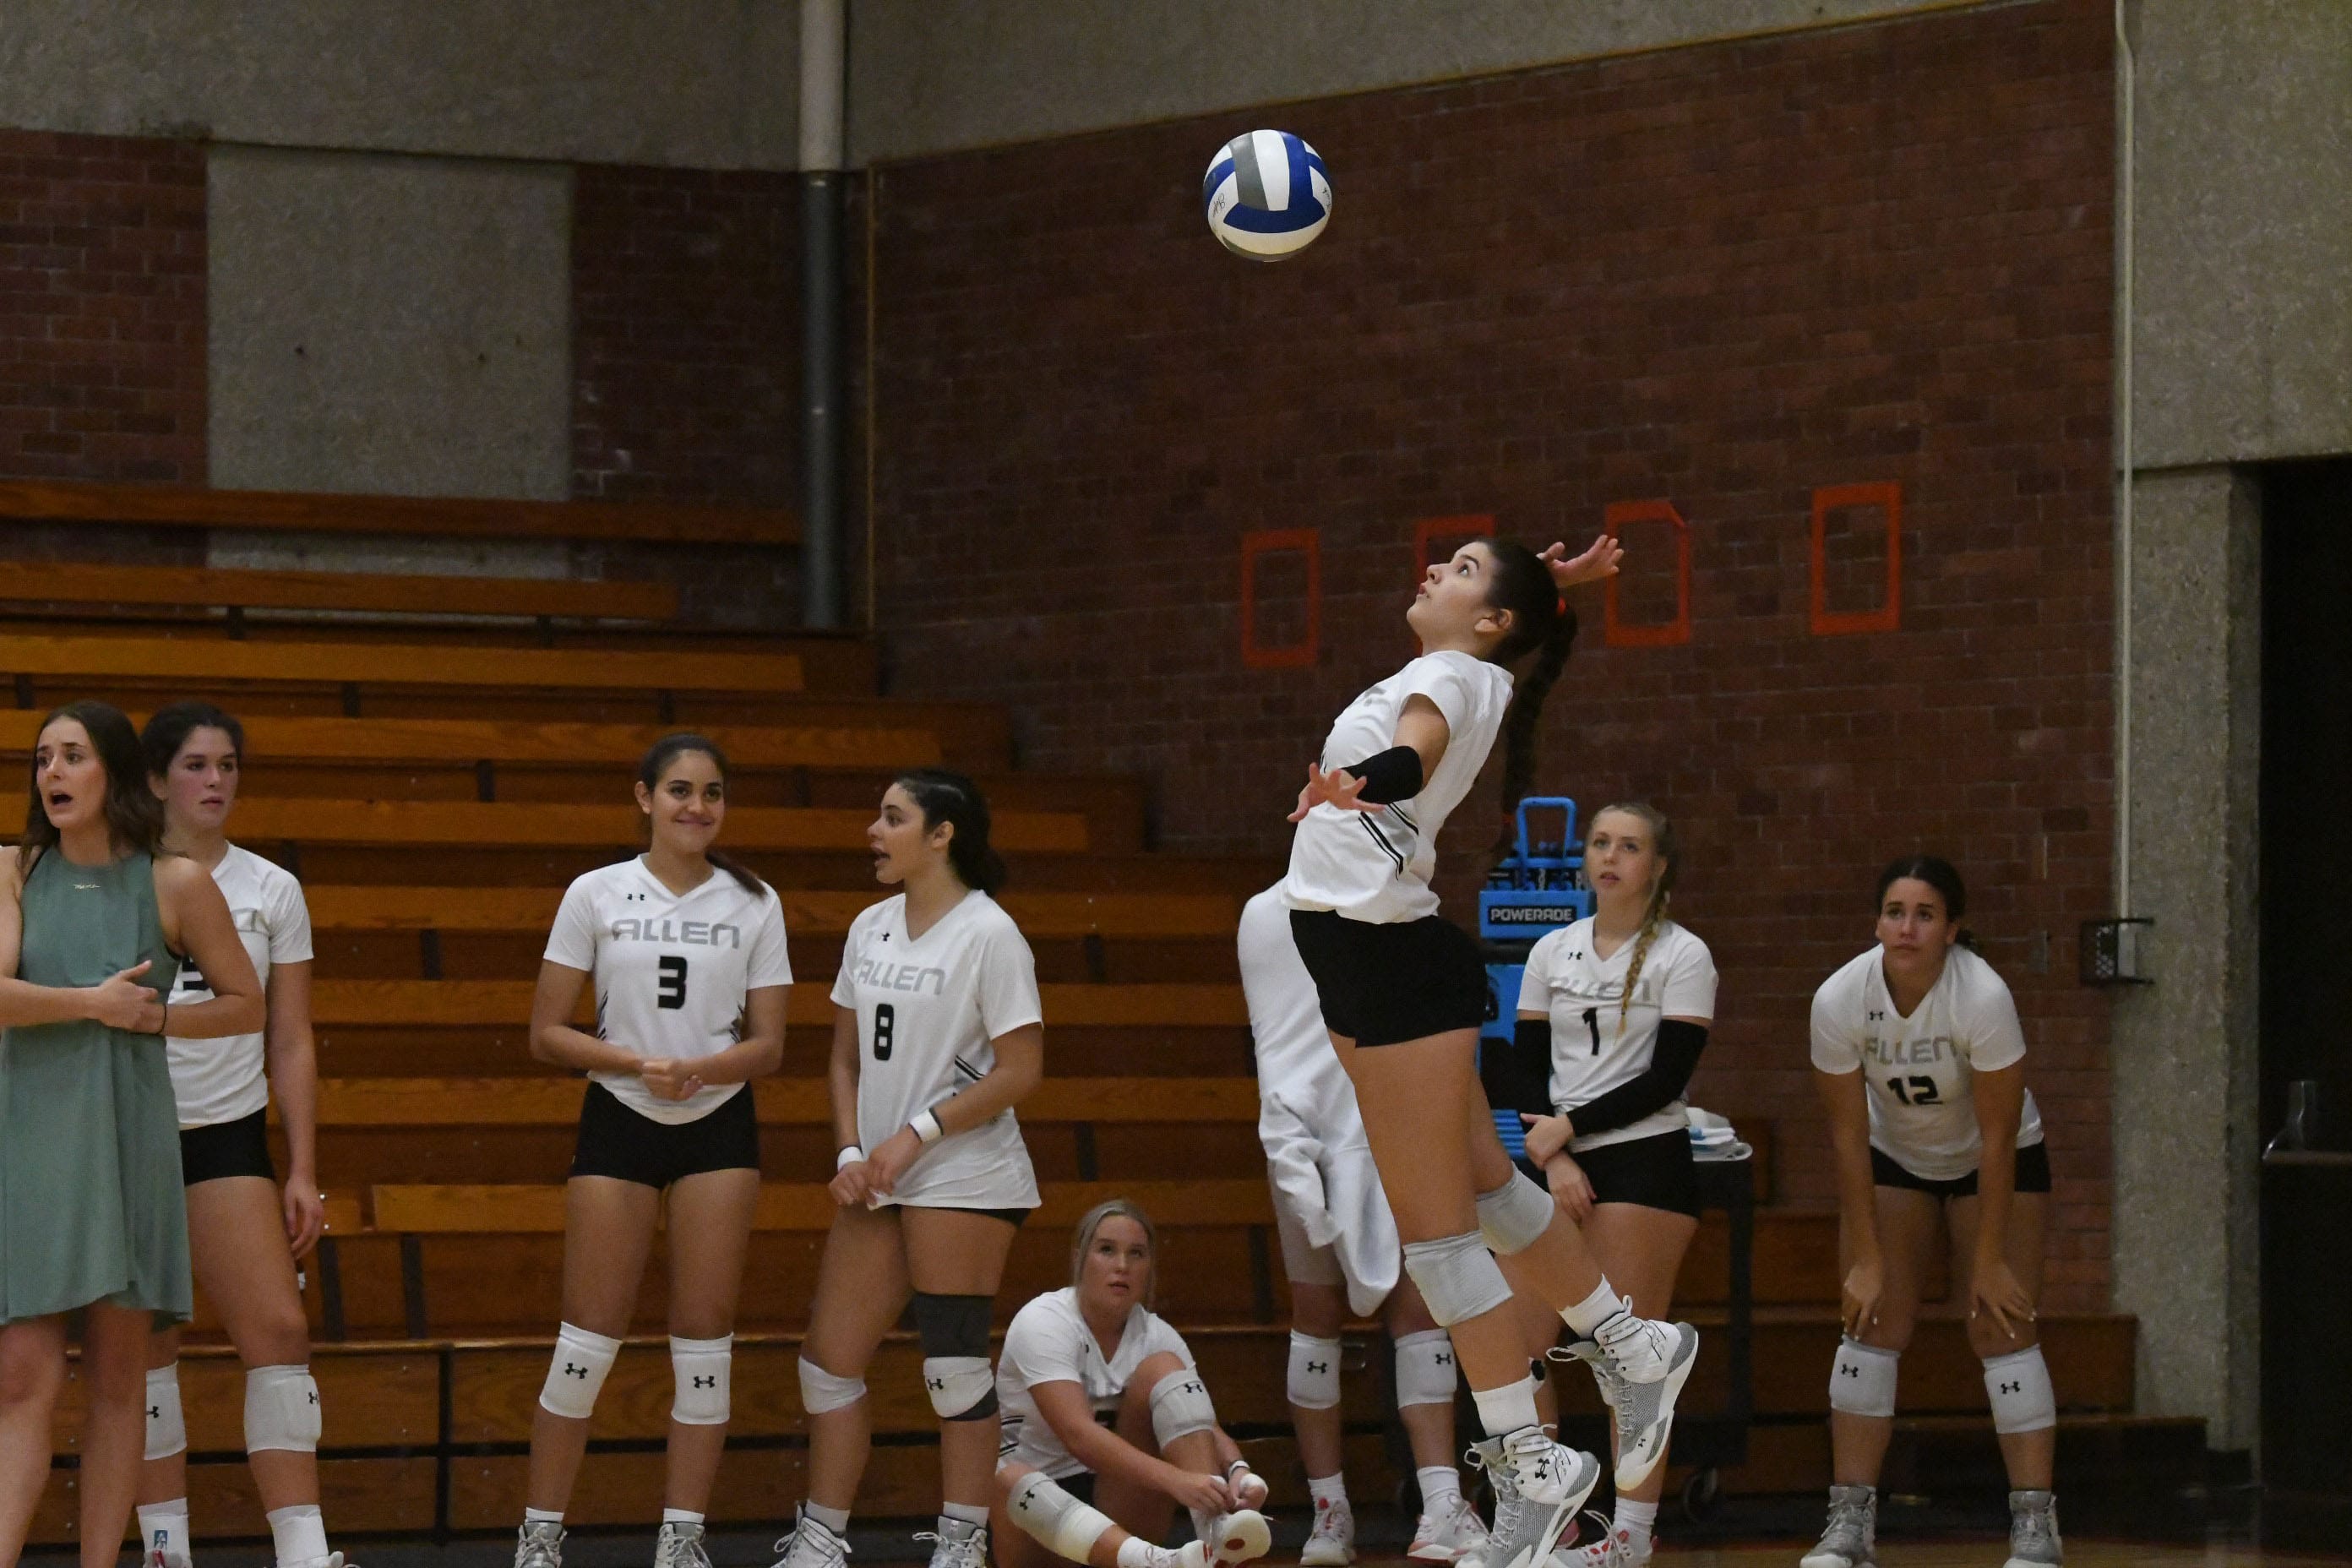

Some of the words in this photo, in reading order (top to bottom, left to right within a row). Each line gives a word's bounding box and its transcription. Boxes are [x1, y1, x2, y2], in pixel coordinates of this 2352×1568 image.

[1490, 907, 1573, 922] POWERADE
[612, 919, 739, 949] ALLEN
[658, 956, 688, 1010] 3
[855, 960, 945, 995] ALLEN
[874, 1004, 894, 1060] 8
[1582, 1008, 1600, 1054] 1
[1887, 1075, 1943, 1105] 12
